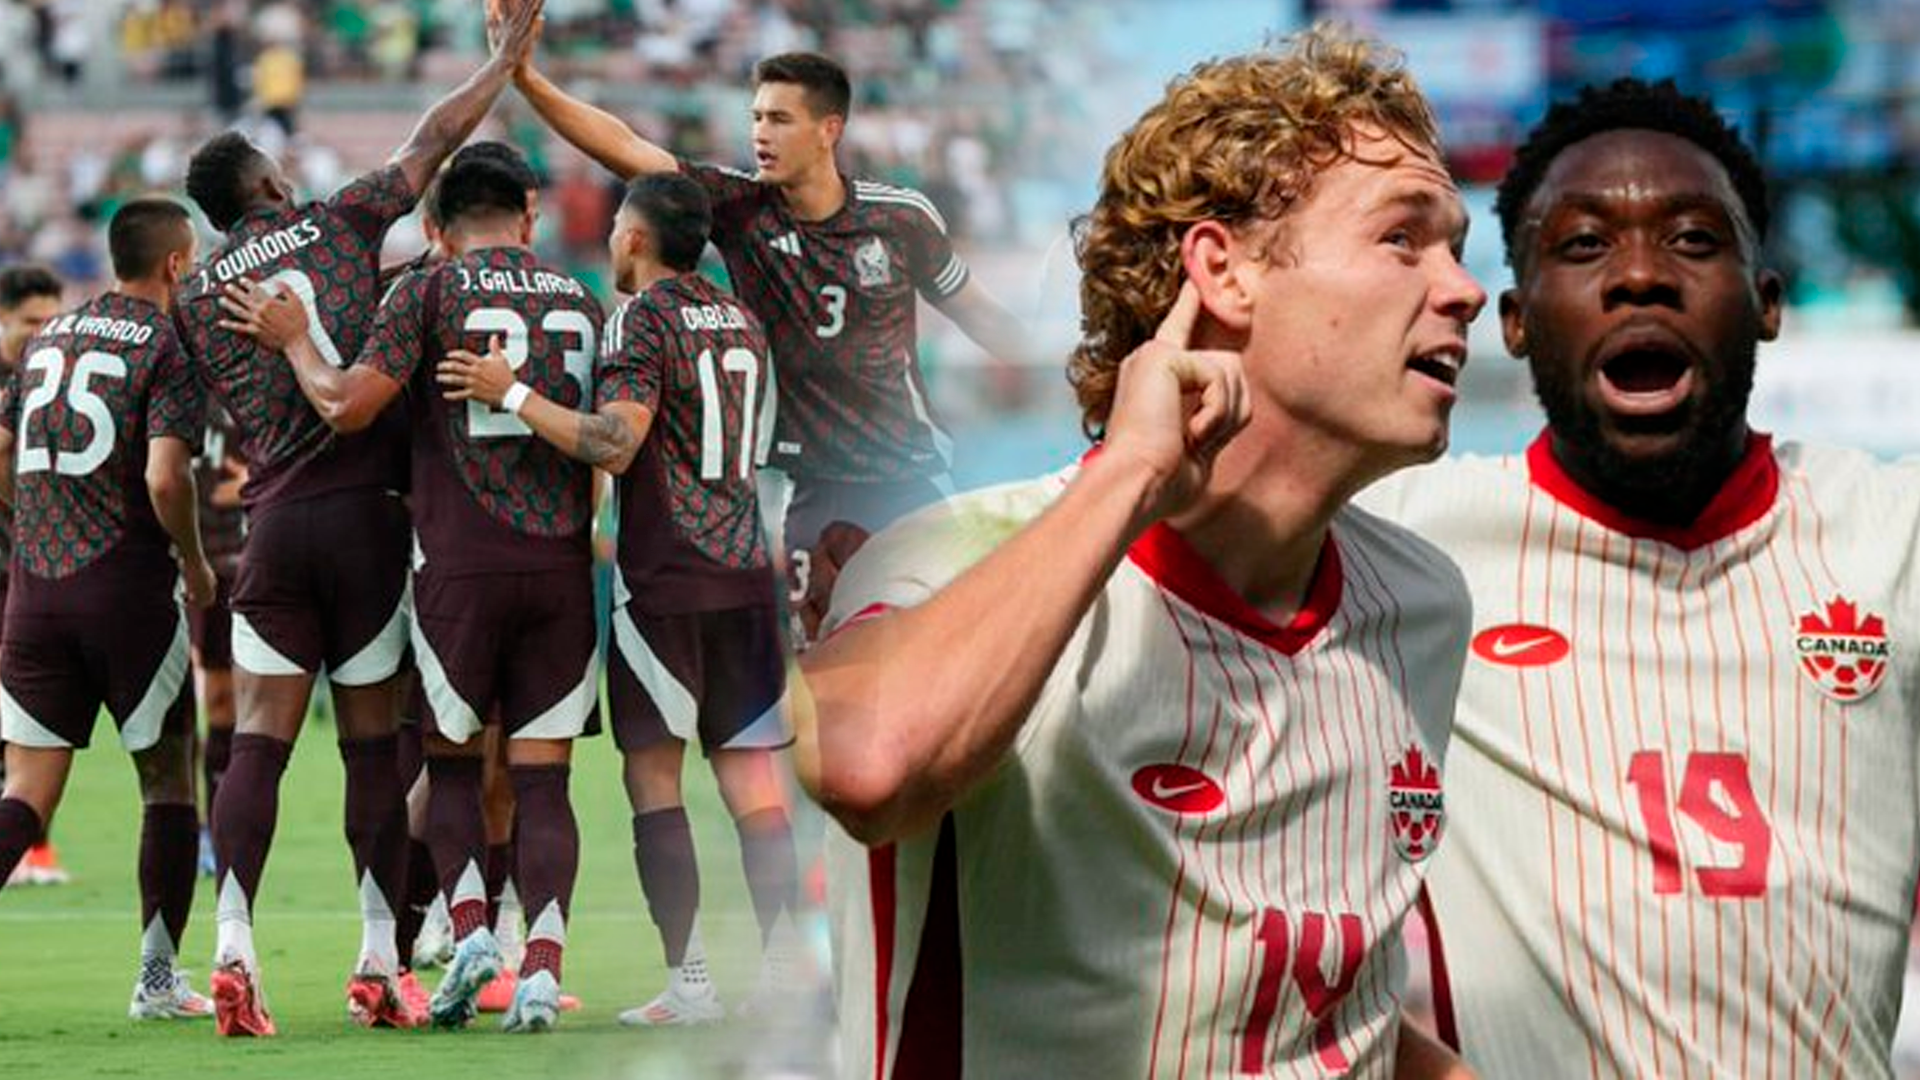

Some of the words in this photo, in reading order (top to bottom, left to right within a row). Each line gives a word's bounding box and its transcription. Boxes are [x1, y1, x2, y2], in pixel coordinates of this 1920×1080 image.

[464, 308, 596, 438] 23
[815, 285, 848, 338] 3
[17, 346, 127, 477] 25
[698, 347, 759, 480] 17
[1796, 637, 1889, 657] CANADA
[1626, 750, 1772, 897] 19
[1240, 905, 1365, 1075] 14
